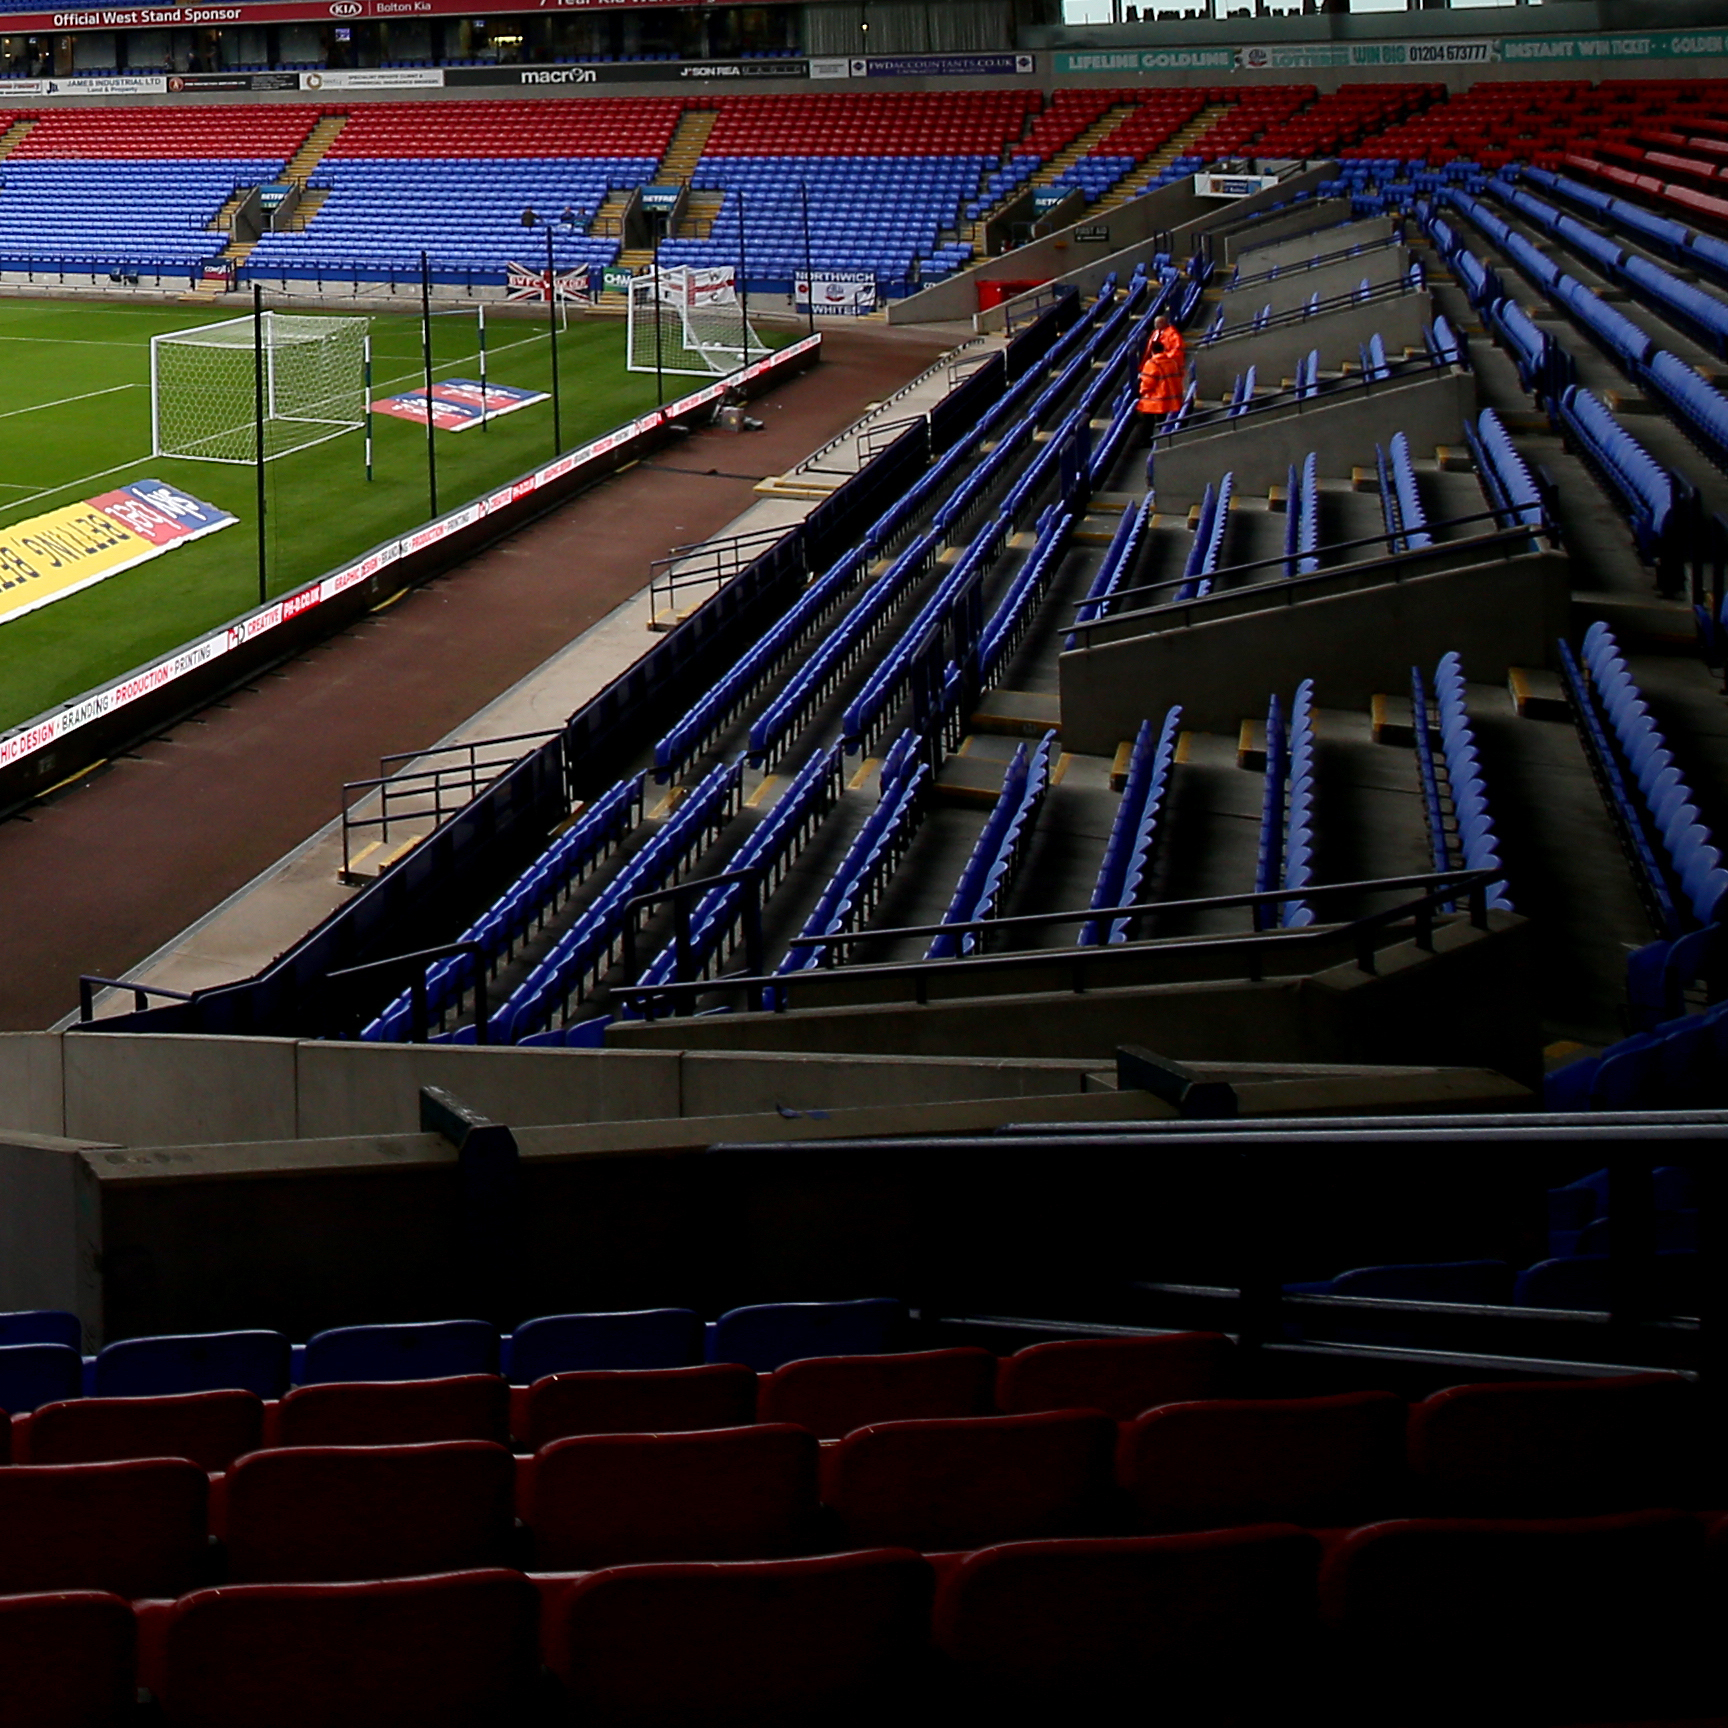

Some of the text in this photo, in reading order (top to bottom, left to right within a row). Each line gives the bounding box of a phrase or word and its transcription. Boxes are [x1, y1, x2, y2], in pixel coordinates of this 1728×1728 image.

[377, 1, 432, 14] Bolton Kia
[53, 8, 242, 27] Official West Stand Sponsor
[1410, 46, 1444, 61] 01204
[521, 68, 597, 83] macron
[795, 271, 875, 282] NORTHWICH
[284, 586, 320, 618] PH-D.CO.UK
[247, 608, 280, 636] CREATIVE
[20, 724, 54, 754] DESIGN
[62, 694, 109, 732] BRANDING
[116, 665, 170, 705] PRODUCTION
[174, 643, 212, 677] PRINTING
